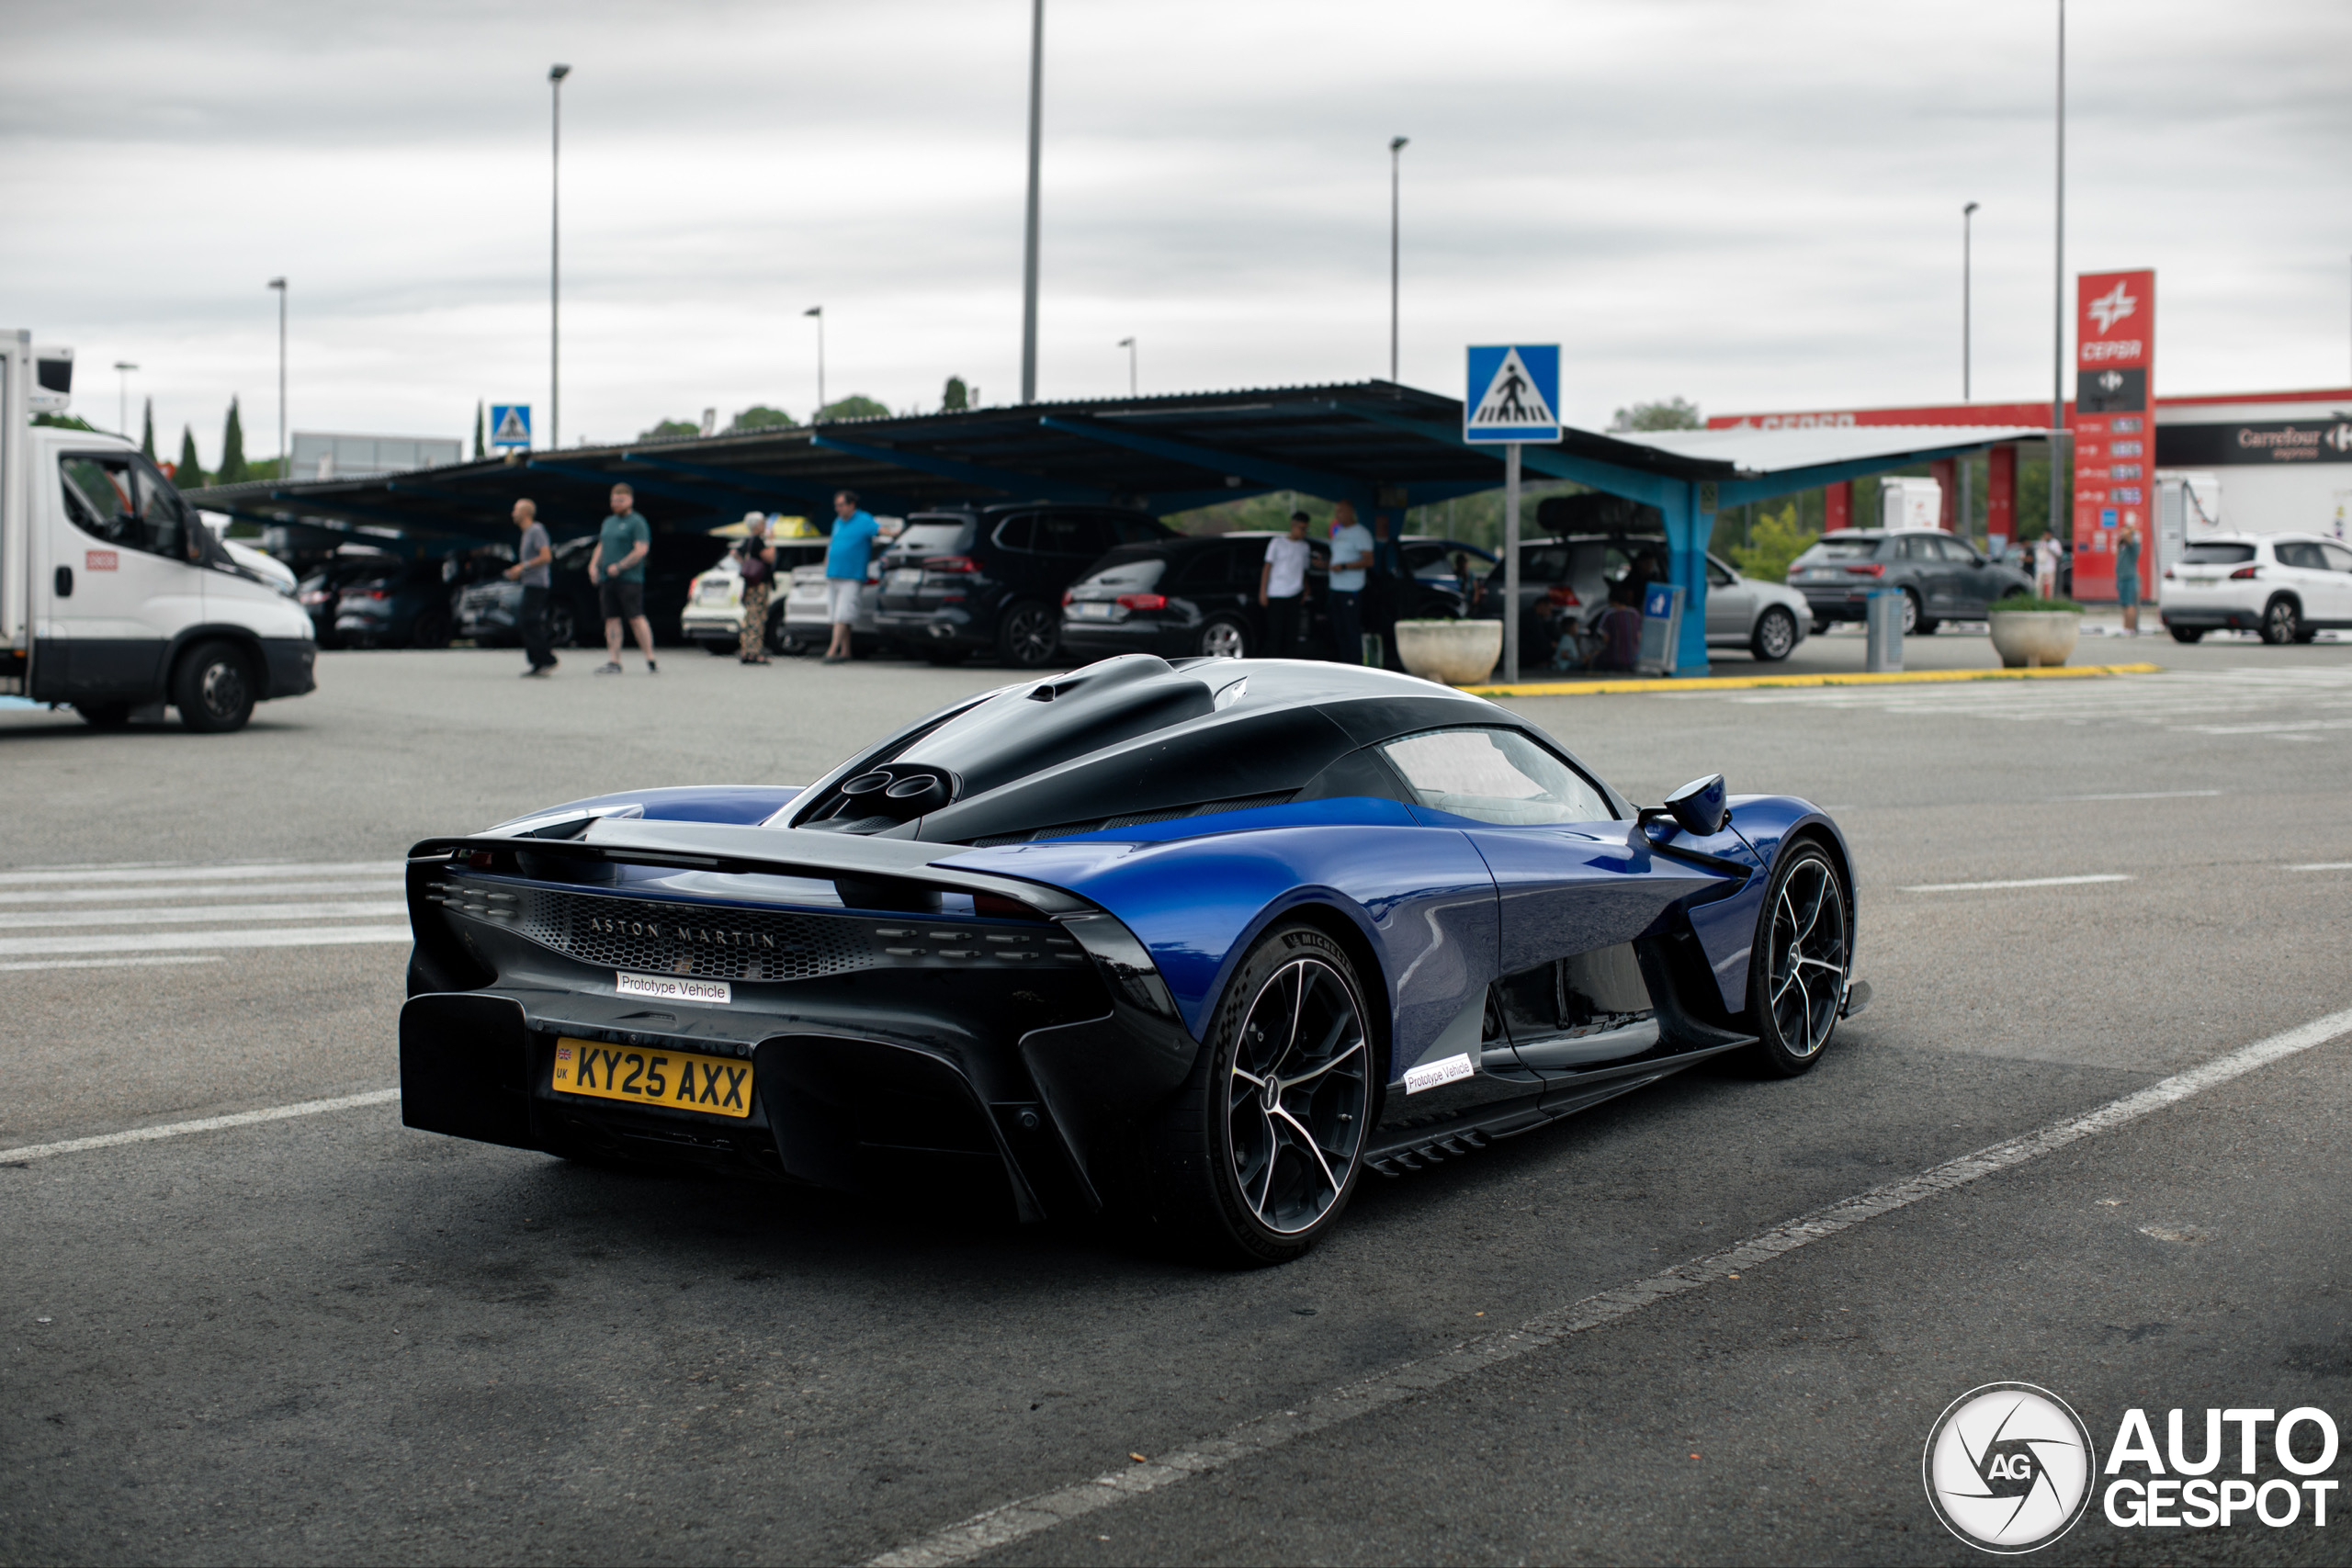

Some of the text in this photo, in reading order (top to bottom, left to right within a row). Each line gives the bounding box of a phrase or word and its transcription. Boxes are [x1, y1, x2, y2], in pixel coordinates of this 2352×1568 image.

[2238, 428, 2322, 448] Carrefour
[591, 918, 775, 948] ASTON MARTIN
[1301, 933, 1352, 975] MICHELIN
[622, 976, 726, 998] Prototype Vehicle
[556, 1046, 747, 1109] UK KY25 AXX
[1408, 1063, 1469, 1089] Prototype Vehicle
